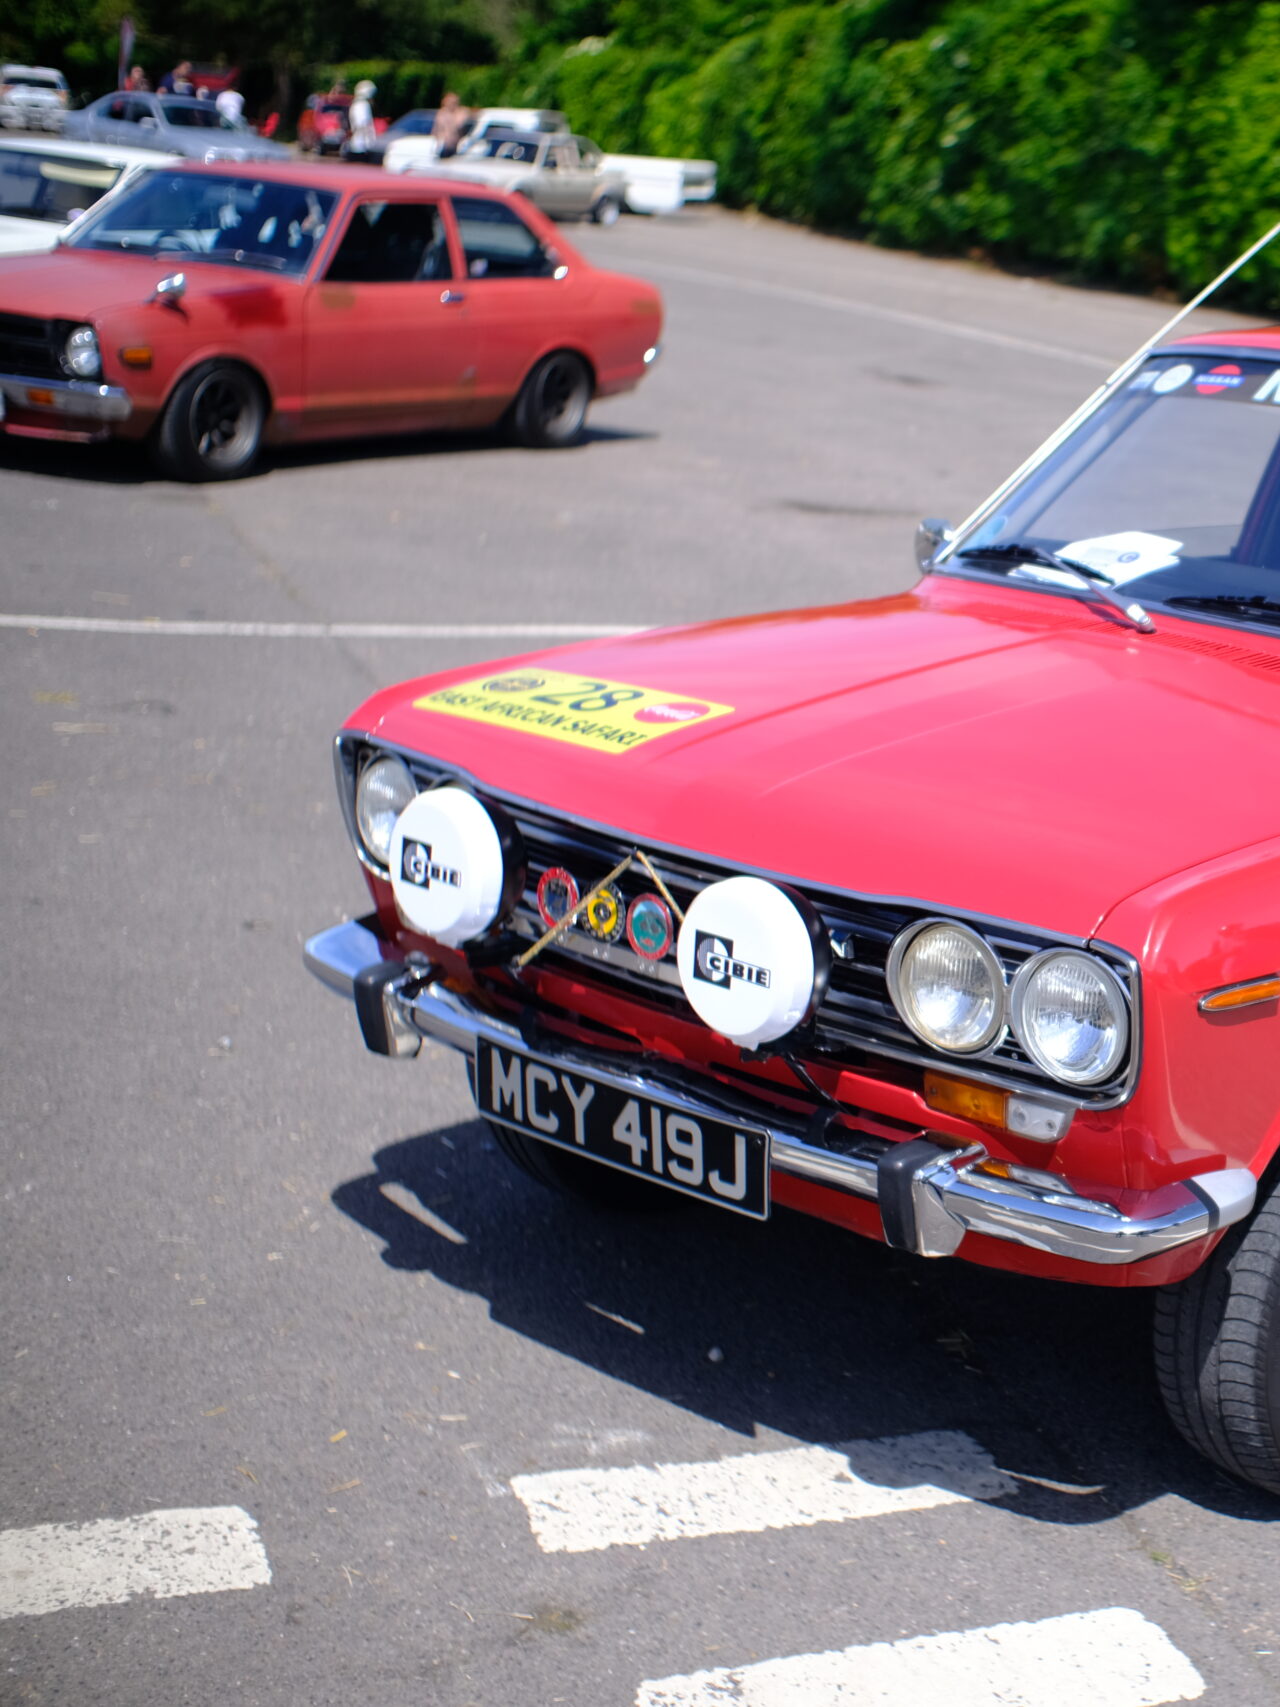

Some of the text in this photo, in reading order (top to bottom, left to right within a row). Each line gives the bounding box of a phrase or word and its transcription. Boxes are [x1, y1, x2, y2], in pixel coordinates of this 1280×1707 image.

[529, 681, 645, 711] 28
[478, 700, 573, 728] AFRICAN
[562, 720, 648, 746] SAFARI
[491, 1047, 747, 1201] MCY 419J
